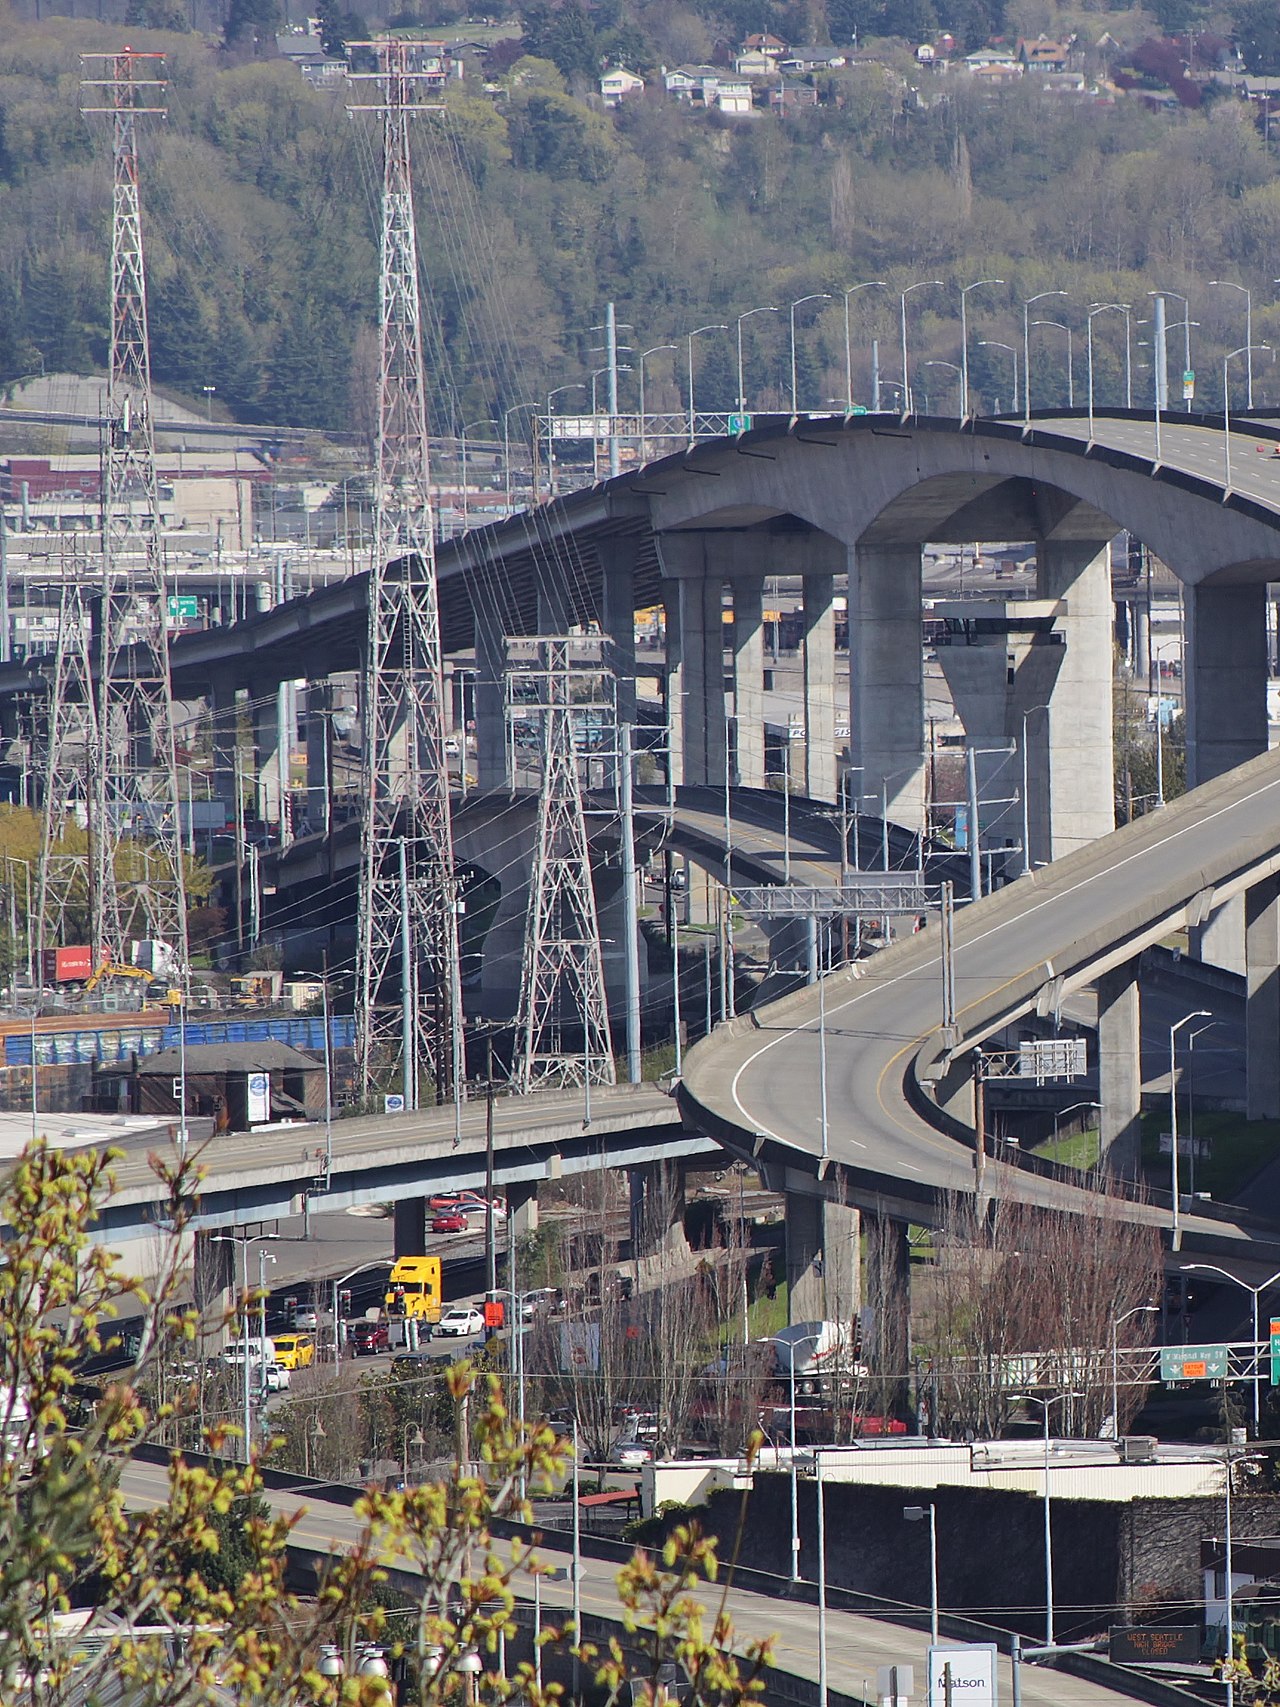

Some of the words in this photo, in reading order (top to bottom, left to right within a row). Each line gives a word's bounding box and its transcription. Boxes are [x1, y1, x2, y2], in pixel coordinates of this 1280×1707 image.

[1127, 1633, 1146, 1641] WEST
[1150, 1633, 1184, 1641] SEATTLE
[1141, 1648, 1169, 1656] CLOSED
[938, 1678, 985, 1688] Matson
